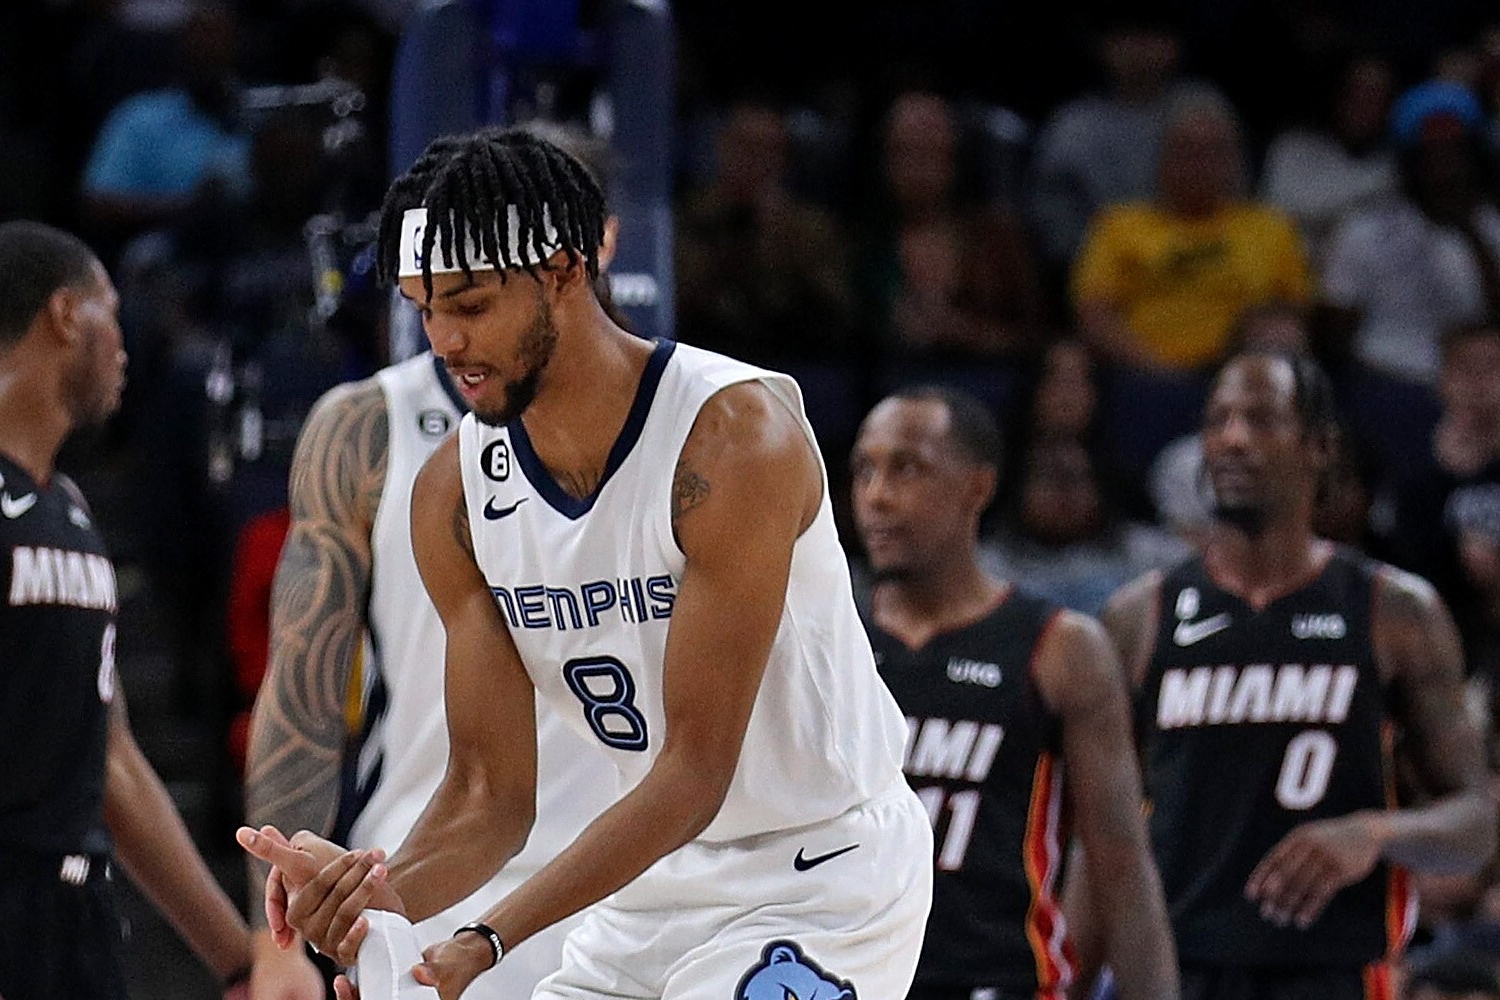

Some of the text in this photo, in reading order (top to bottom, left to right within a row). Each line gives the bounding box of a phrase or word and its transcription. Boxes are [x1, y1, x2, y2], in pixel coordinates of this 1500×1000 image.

[491, 444, 508, 478] 6
[564, 655, 648, 751] 8
[1158, 665, 1359, 731] MIAMI
[1274, 731, 1337, 810] 0
